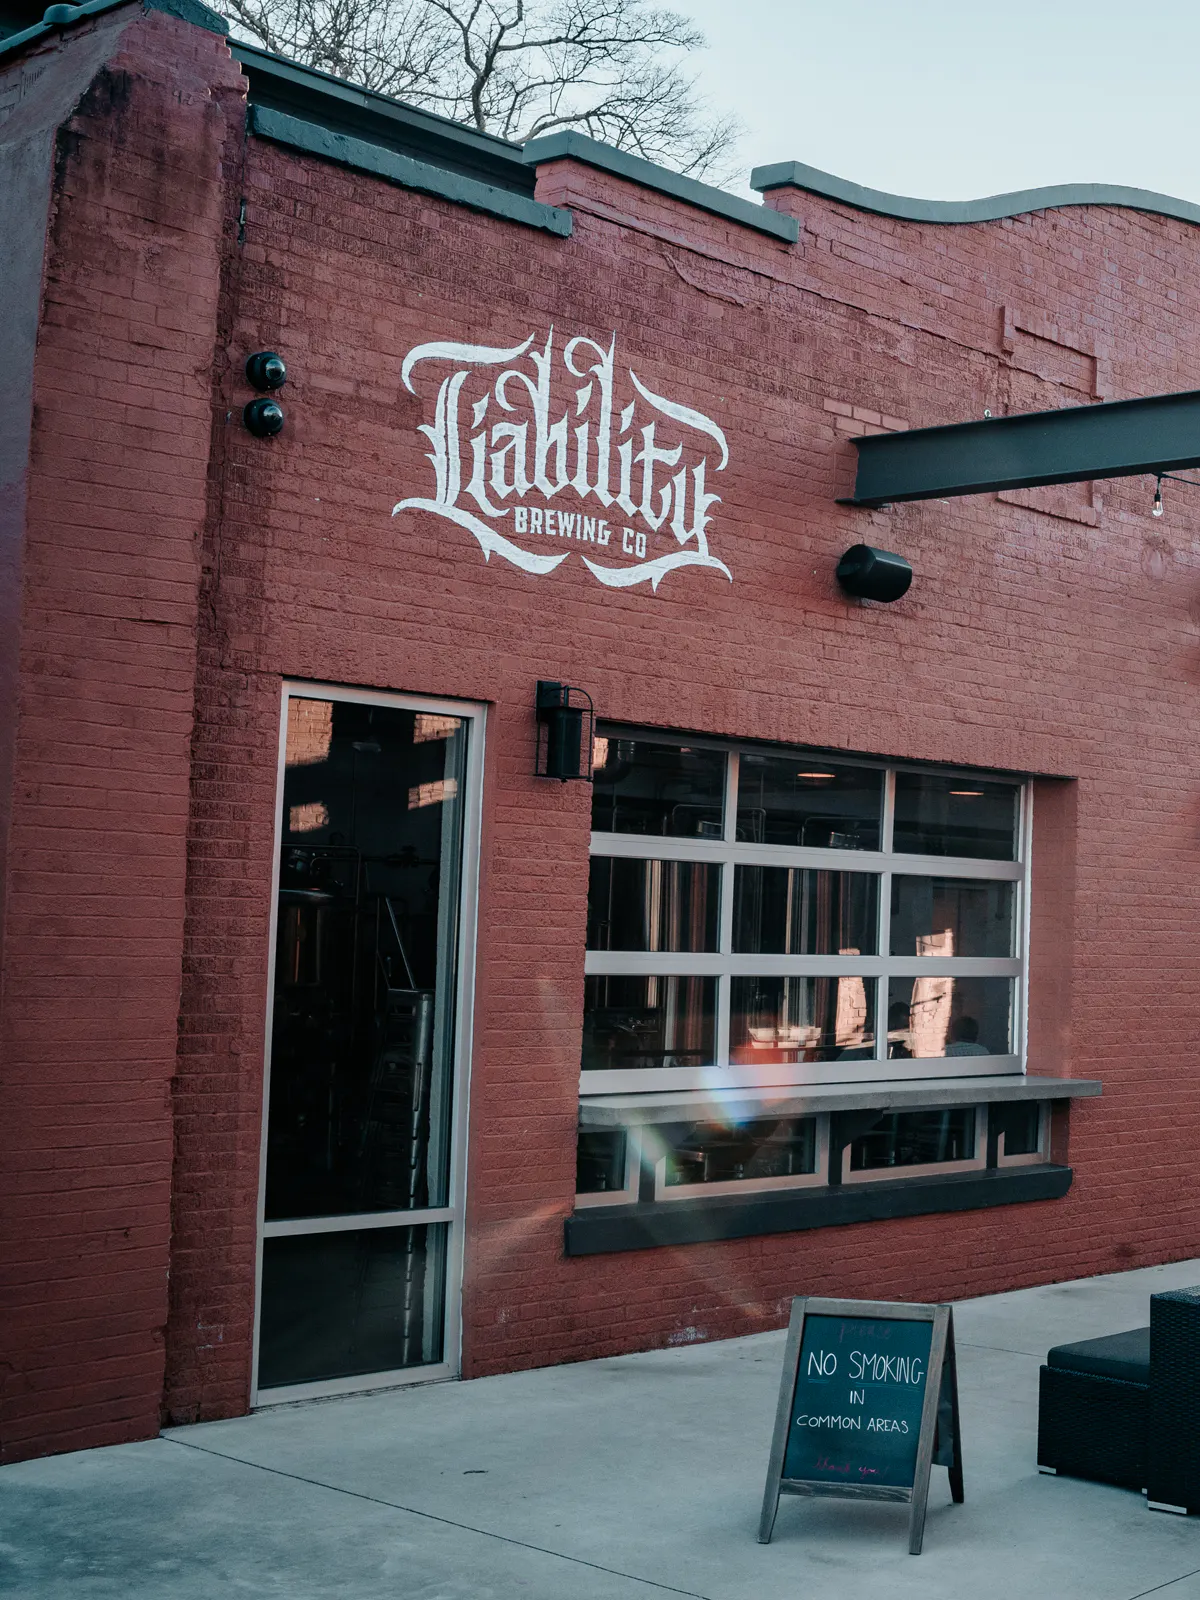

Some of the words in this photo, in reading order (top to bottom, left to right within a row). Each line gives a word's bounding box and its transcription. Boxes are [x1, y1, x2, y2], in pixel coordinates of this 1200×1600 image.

[391, 323, 734, 594] Liability
[514, 506, 613, 546] BREWING
[621, 526, 647, 558] CO
[807, 1350, 838, 1376] NO
[848, 1351, 925, 1384] SMOKING
[849, 1388, 865, 1406] IN
[796, 1414, 861, 1431] COMMON
[866, 1417, 909, 1434] AREAS
